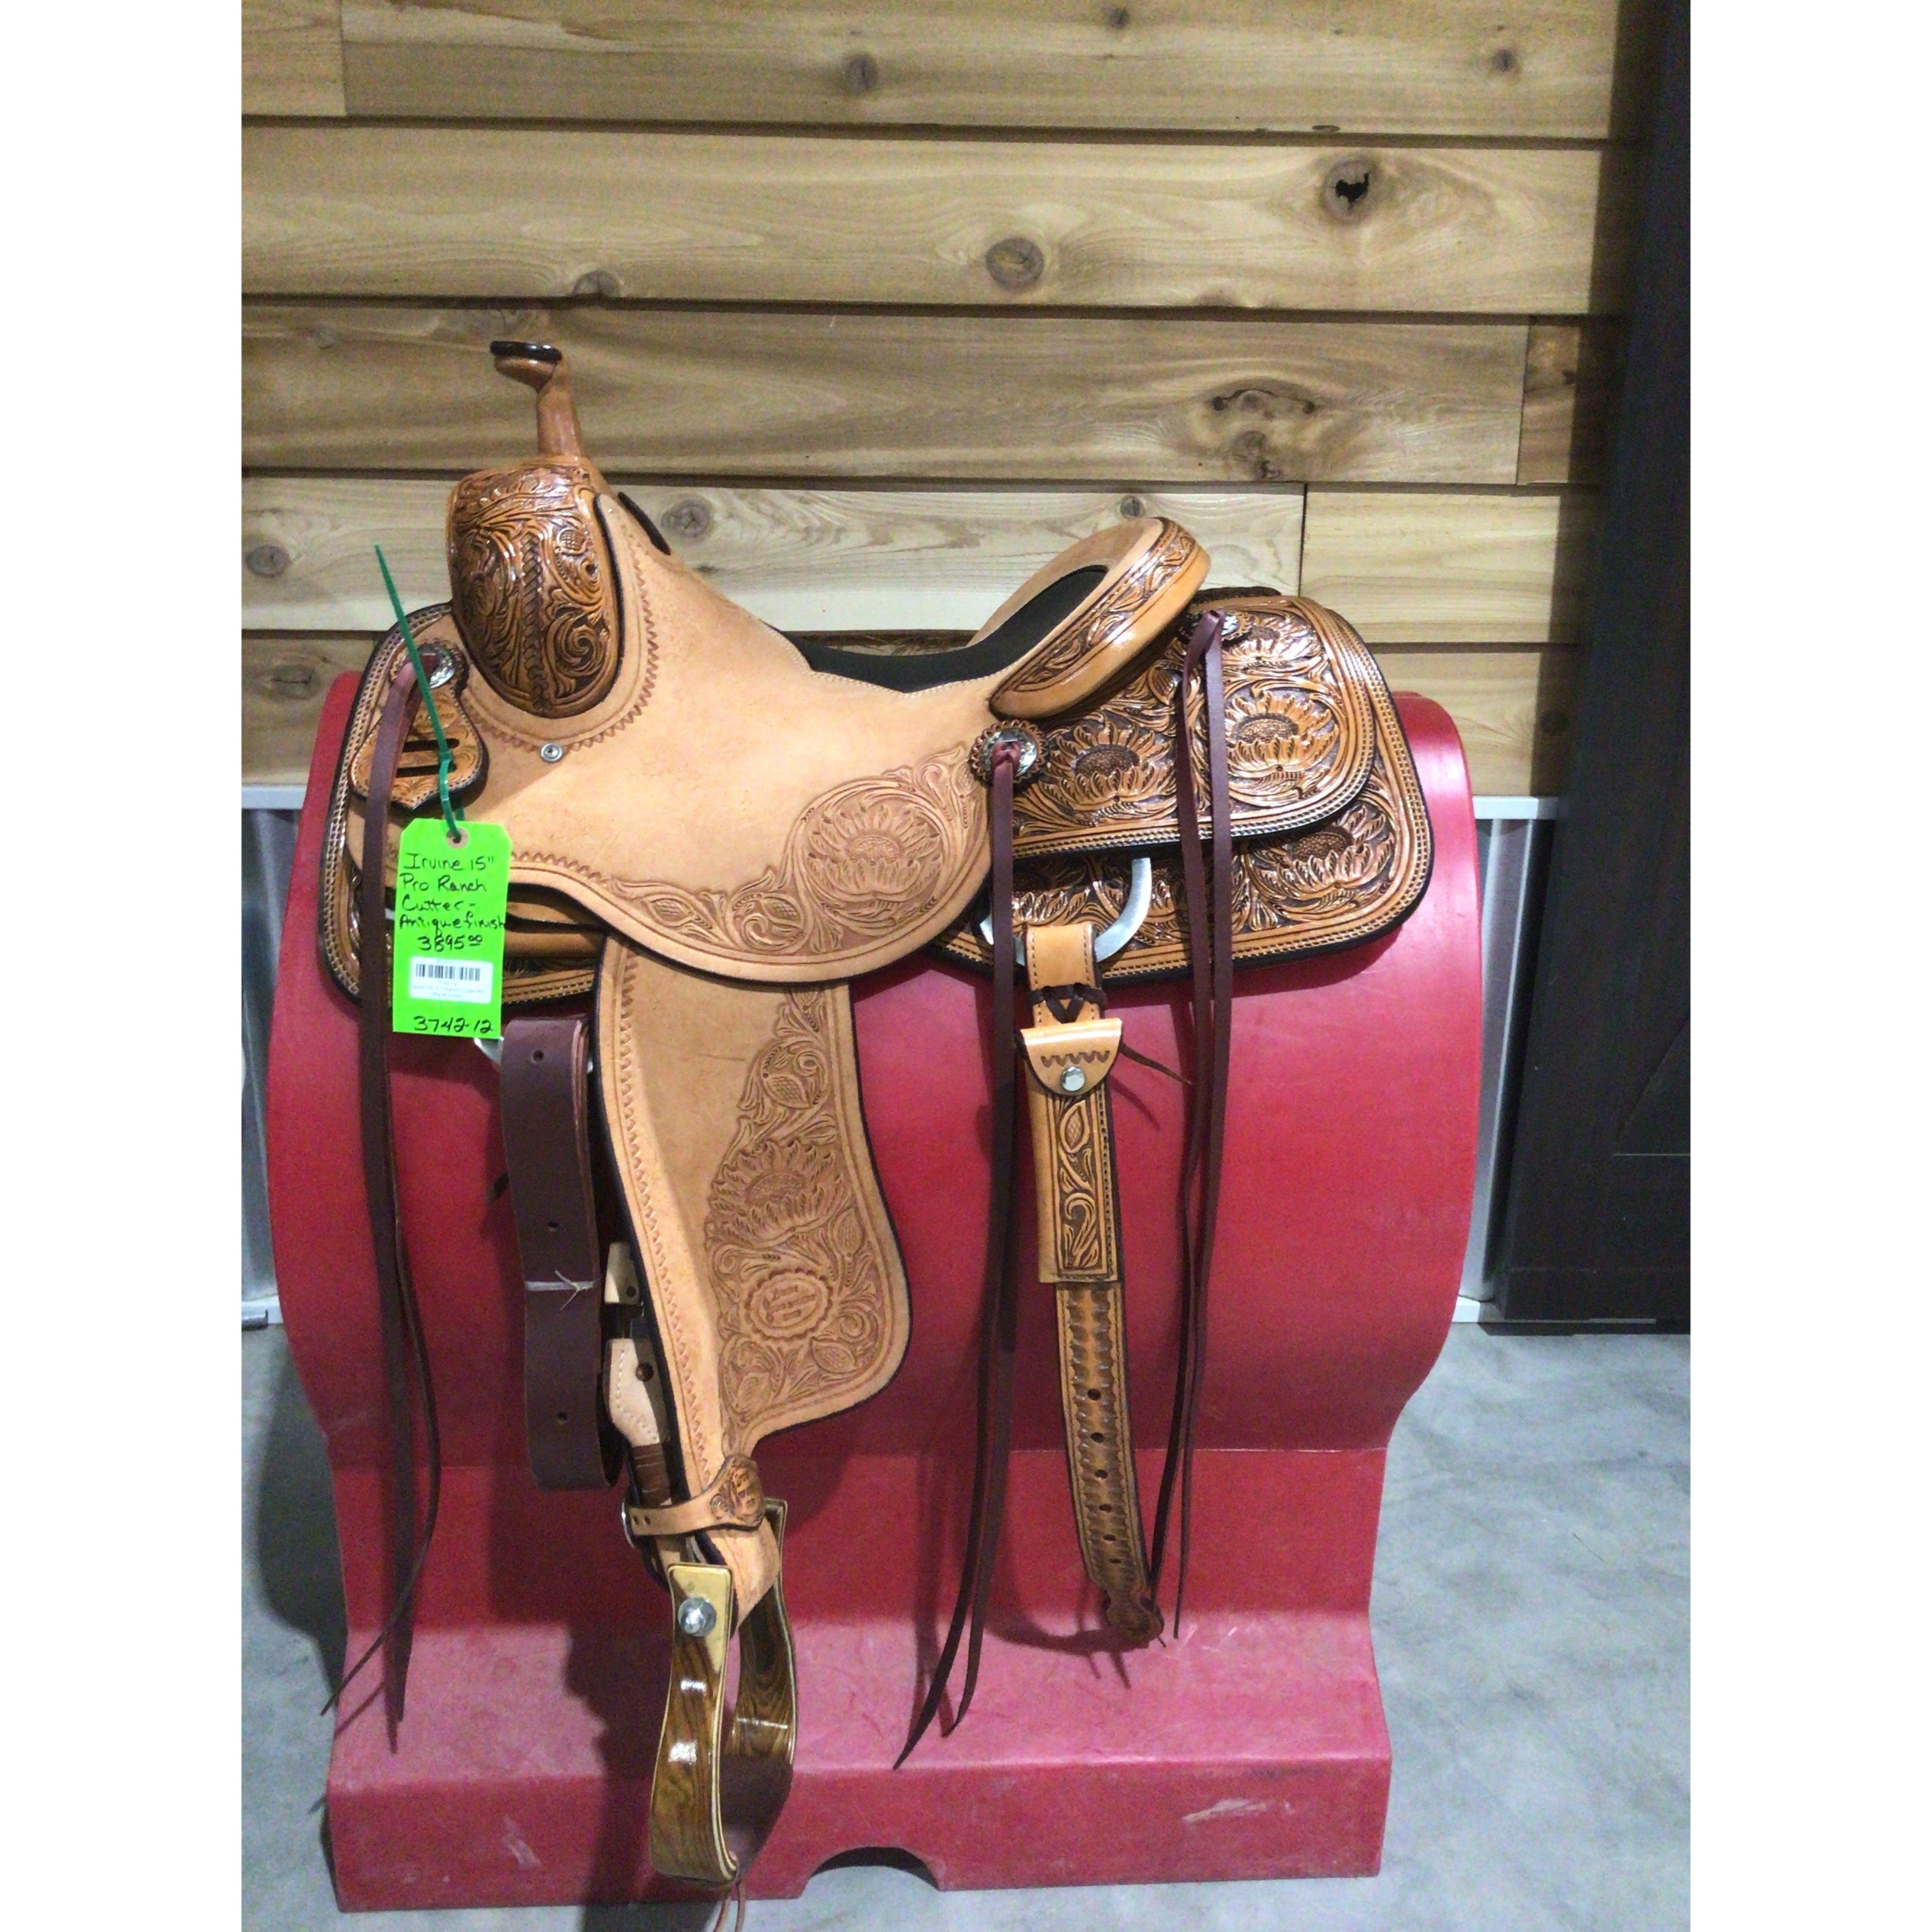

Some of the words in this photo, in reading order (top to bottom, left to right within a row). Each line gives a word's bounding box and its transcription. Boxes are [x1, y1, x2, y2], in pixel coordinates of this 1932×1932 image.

[404, 852, 465, 871] Irvine
[399, 872, 429, 891] Pro
[438, 875, 487, 891] Ranch
